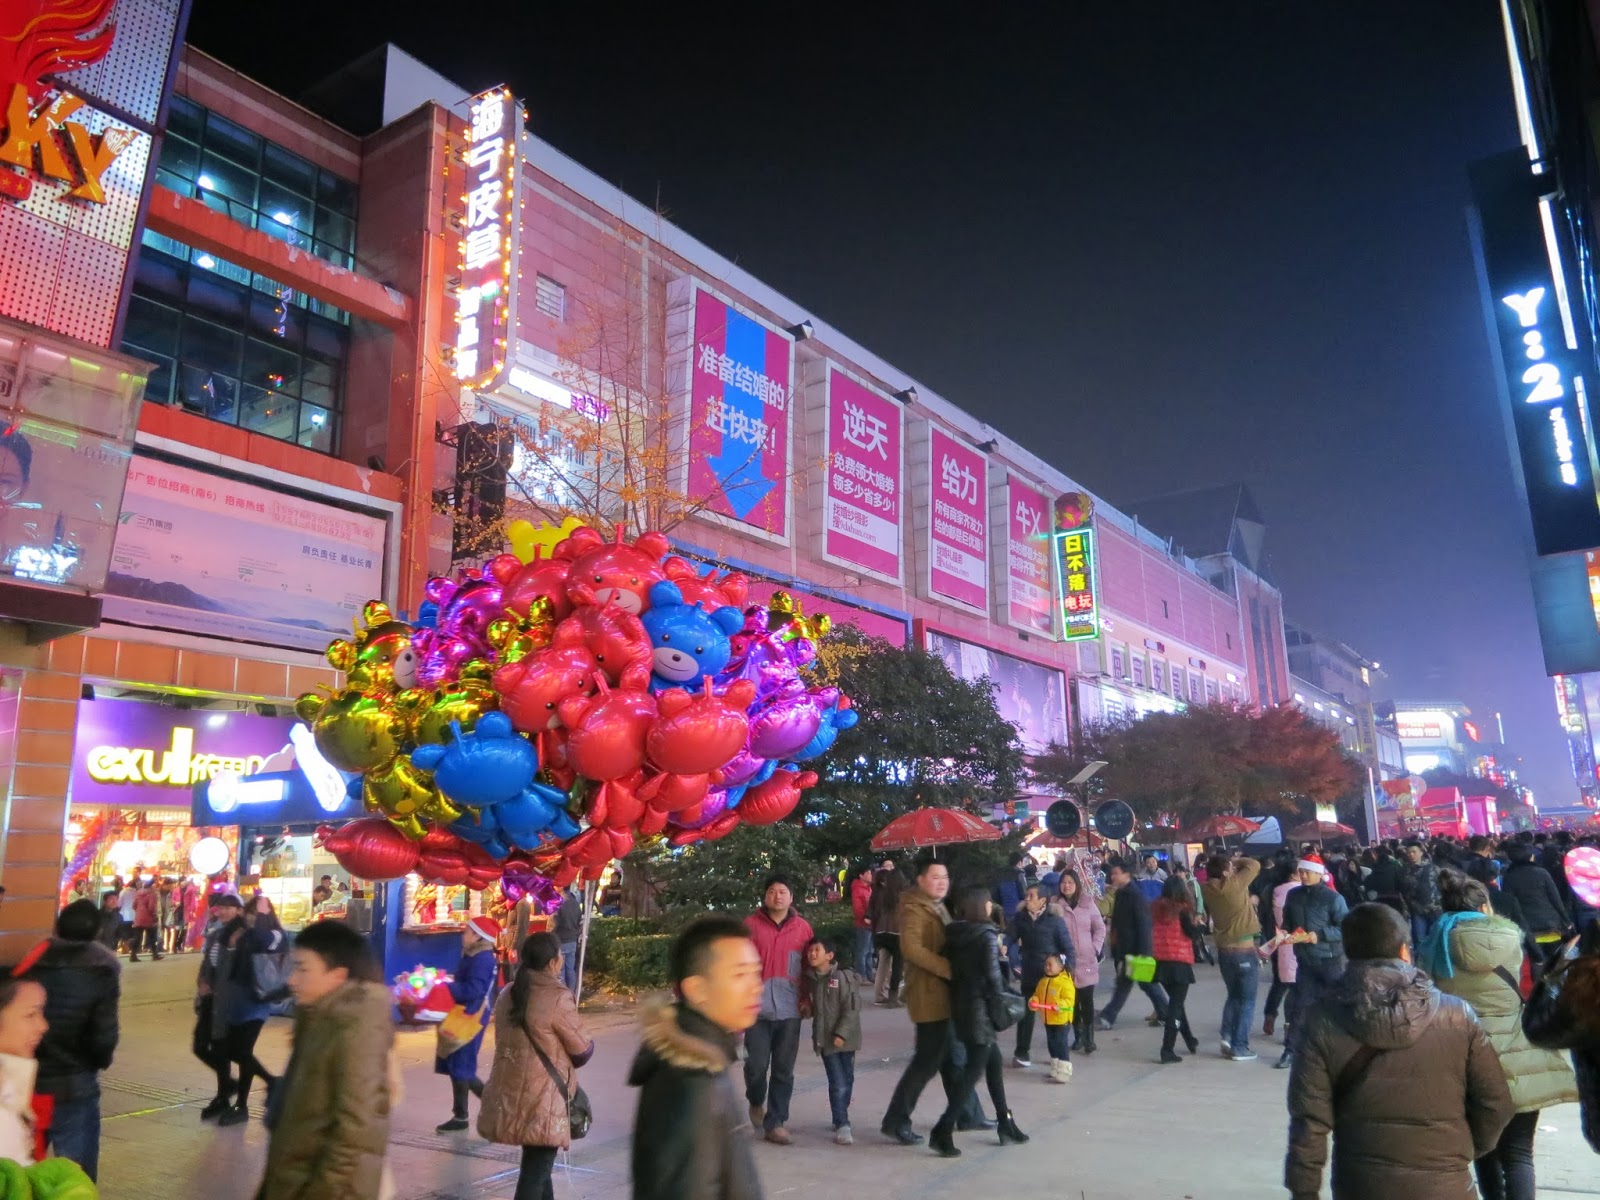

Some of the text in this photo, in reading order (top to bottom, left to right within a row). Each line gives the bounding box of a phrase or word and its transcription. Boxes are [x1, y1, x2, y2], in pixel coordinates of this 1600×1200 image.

[698, 343, 785, 411] 准备结婚的
[842, 400, 888, 461] 逆天
[833, 452, 895, 495] 免费领大婚券
[942, 453, 977, 506] 给力
[1065, 535, 1087, 591] 日不落
[1065, 594, 1093, 610] 电玩
